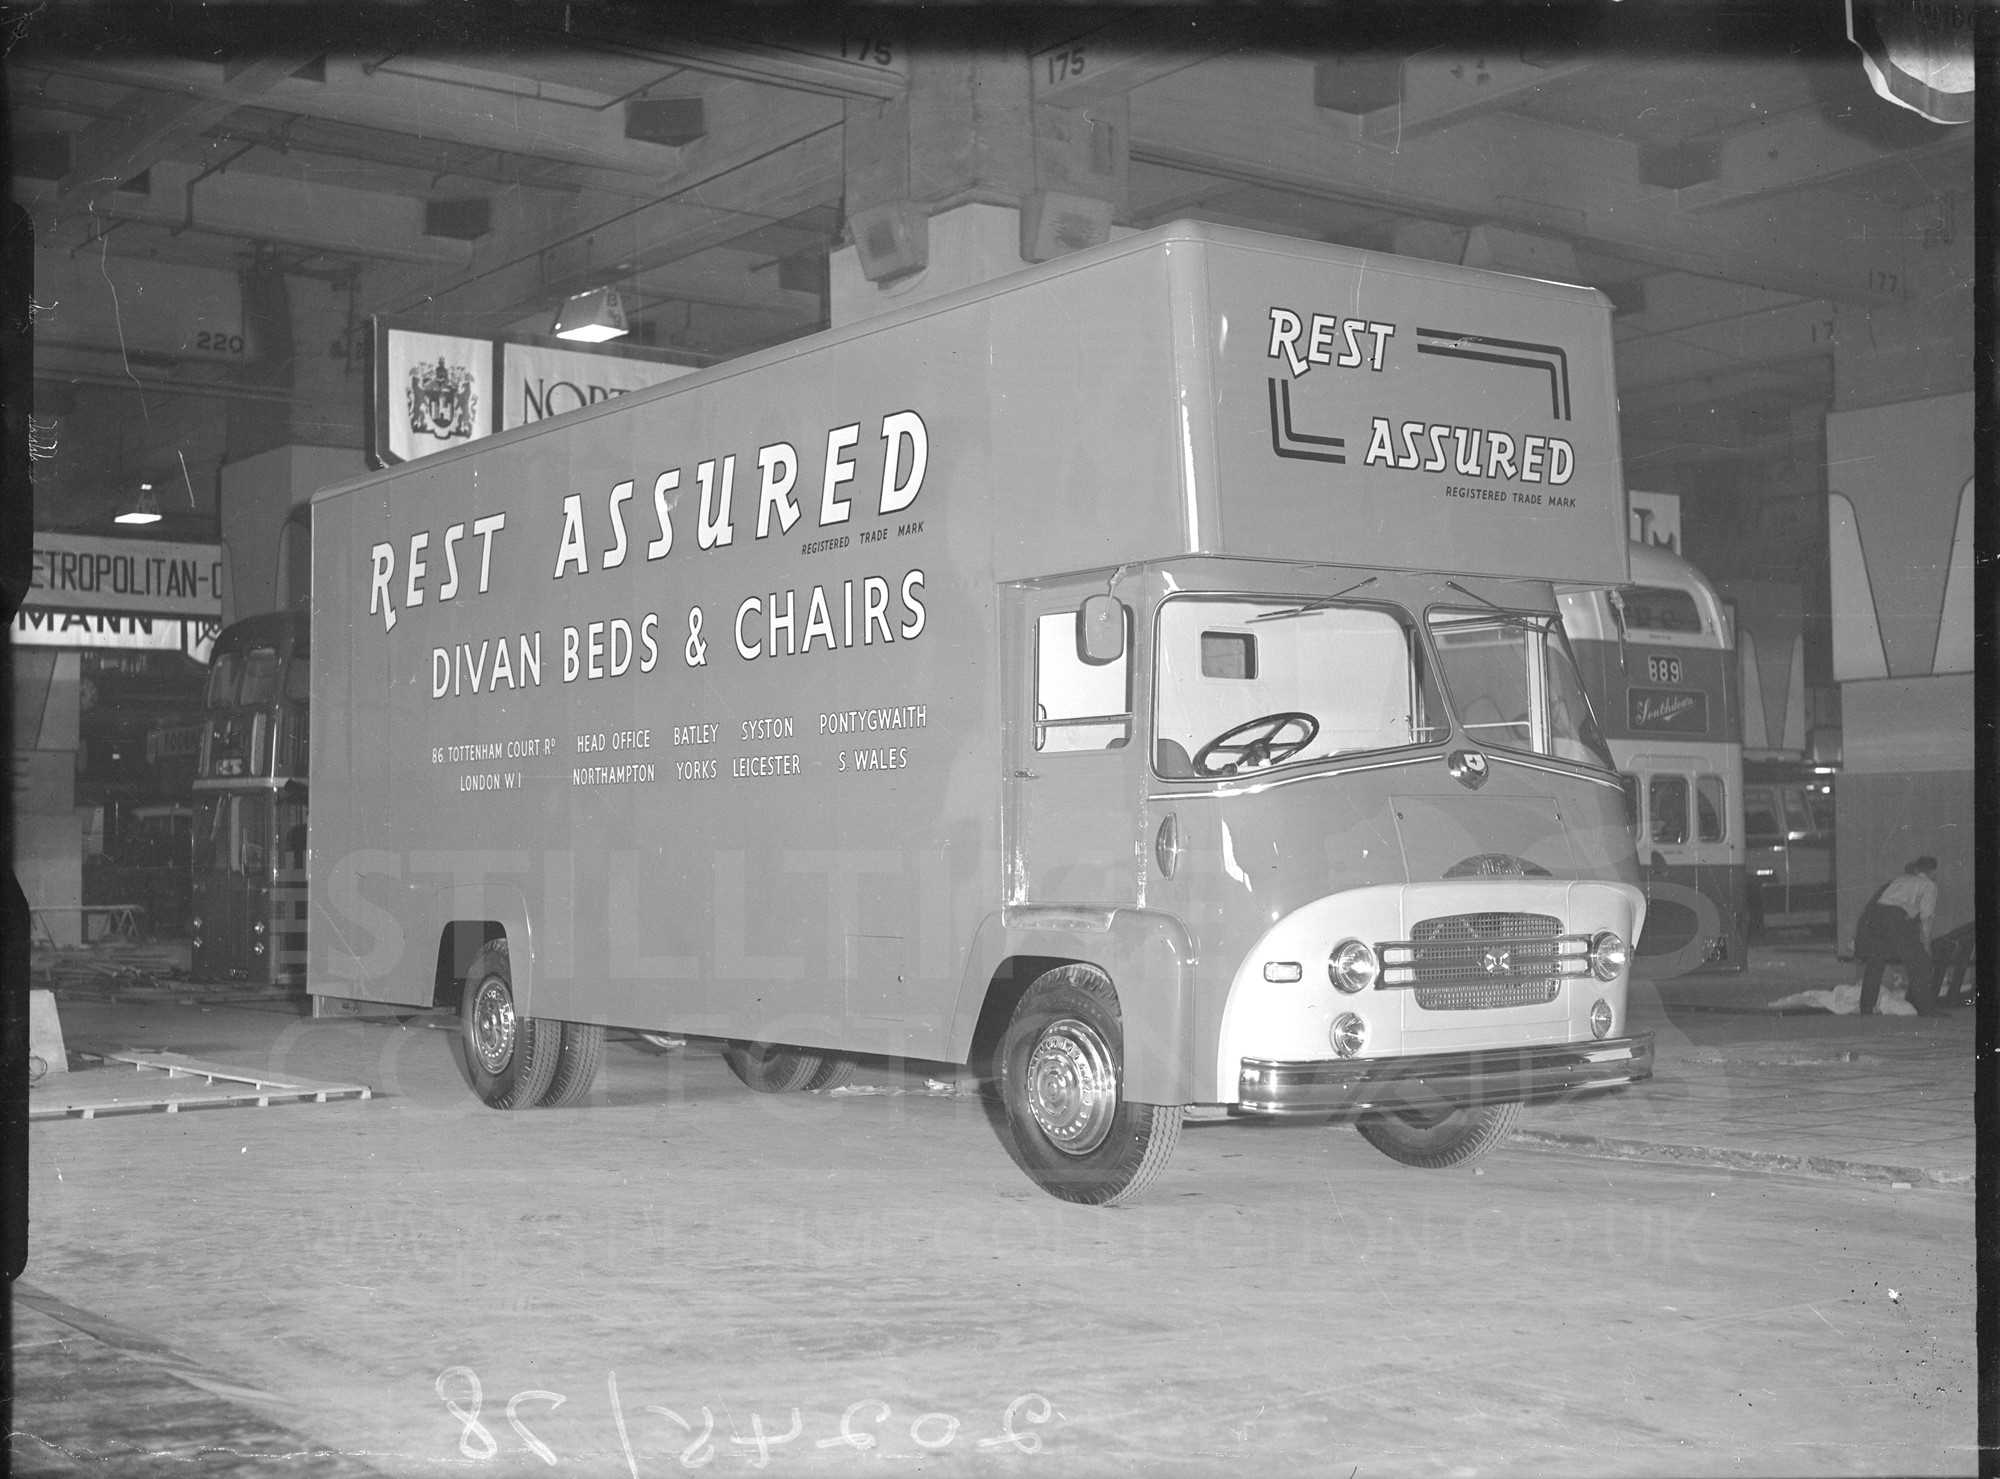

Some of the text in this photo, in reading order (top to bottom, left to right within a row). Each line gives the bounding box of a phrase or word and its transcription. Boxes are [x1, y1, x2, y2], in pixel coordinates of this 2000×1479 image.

[1048, 48, 1085, 84] 175
[197, 331, 244, 354] 220
[1268, 307, 1396, 379] REST
[523, 377, 634, 424] NO
[1364, 416, 1575, 485] ASSURED
[1446, 486, 1576, 508] REGISTERED TRADE MARK
[369, 409, 929, 633] REST ASSURED
[801, 521, 924, 555] REGISTERED TRADE MARK
[431, 568, 927, 700] DIVAN BEDS & CHAIRS
[740, 717, 793, 741] SYSTON
[819, 704, 927, 735] PONTYGWAITH
[577, 729, 651, 754] HEAD OFFICE
[673, 723, 720, 746] BATLEY
[431, 747, 444, 764] 86
[449, 743, 503, 763] TOTTENHAM
[507, 739, 540, 760] COURT
[854, 747, 908, 771] WALES
[572, 763, 656, 786] NORTHAMPTON
[676, 759, 718, 781] YORKS
[732, 754, 801, 778] LEICESTER
[460, 773, 501, 792] LONDON
